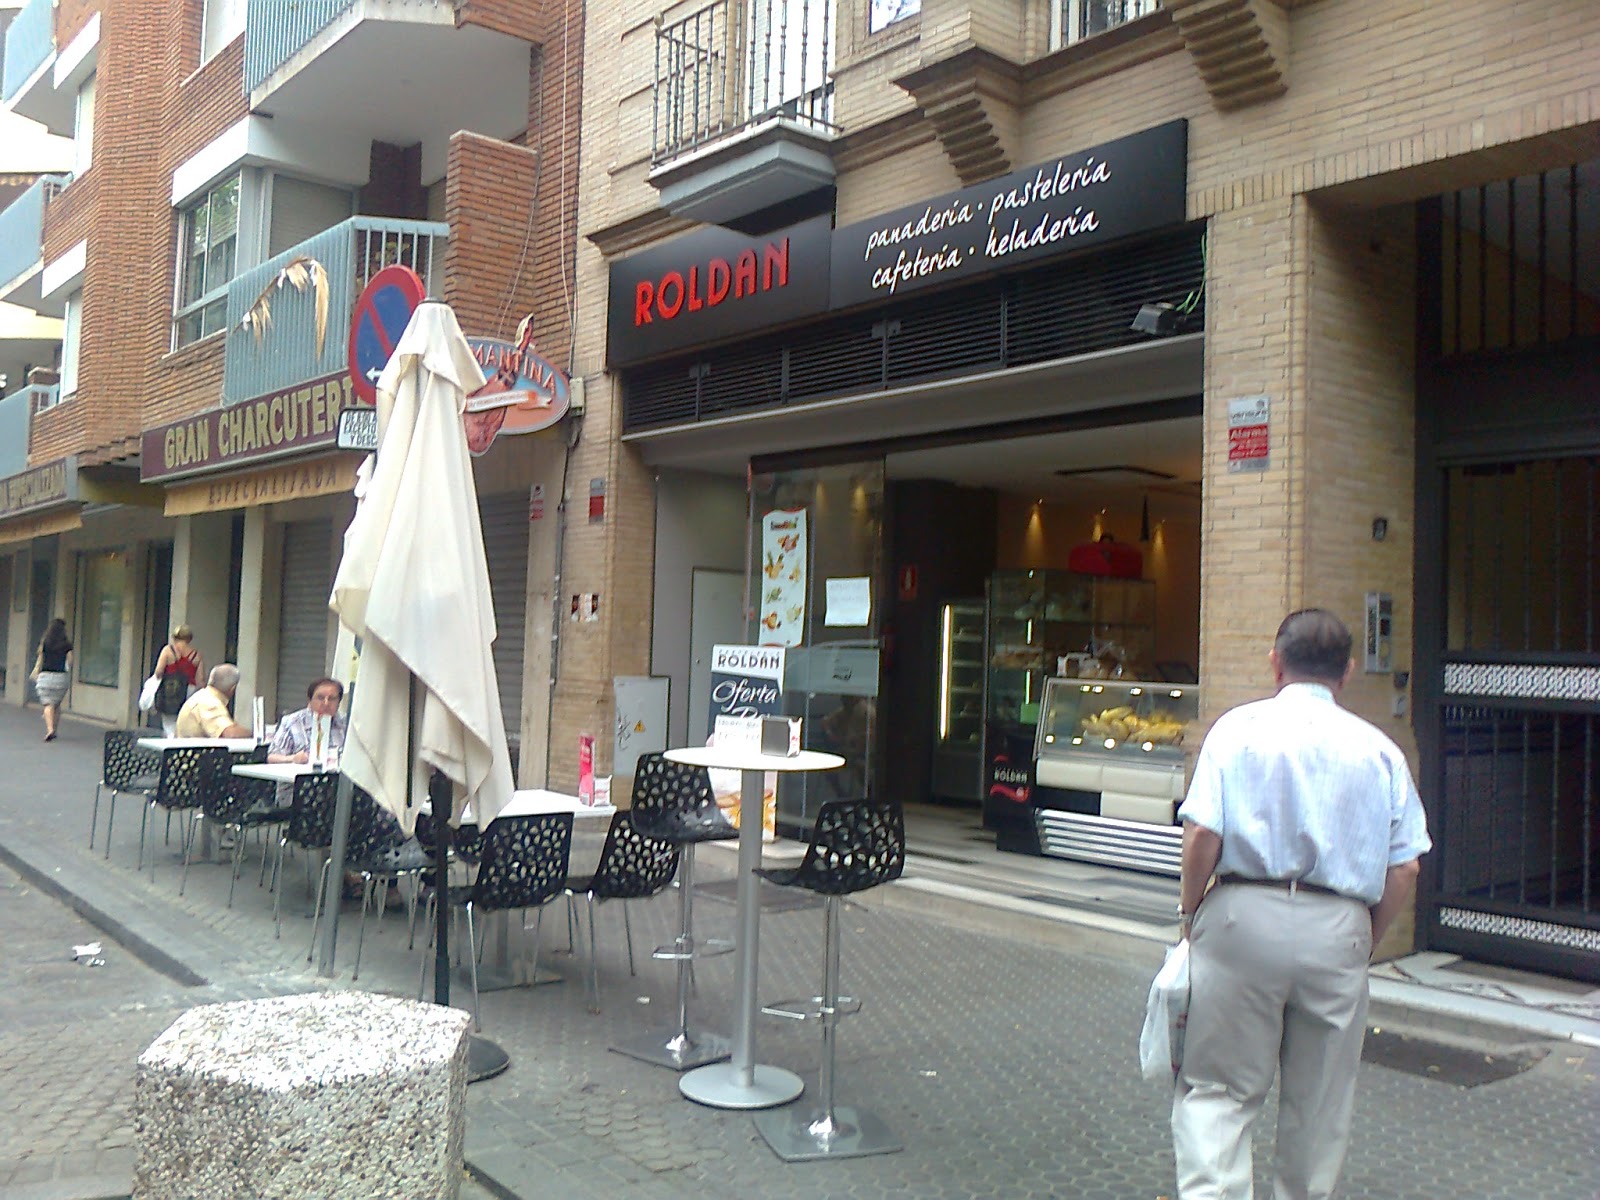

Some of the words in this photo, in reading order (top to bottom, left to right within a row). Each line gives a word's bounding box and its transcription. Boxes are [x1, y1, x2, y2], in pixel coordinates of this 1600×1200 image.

[864, 200, 974, 261] panadería
[988, 157, 1112, 224] pastelería
[871, 244, 963, 294] cafetería
[985, 206, 1100, 257] heladería
[635, 237, 789, 327] ROLDAN
[164, 418, 210, 469] GRAN
[218, 375, 375, 457] CHARCUTERI
[712, 678, 778, 713] Oferta
[717, 654, 780, 670] ROLDAN
